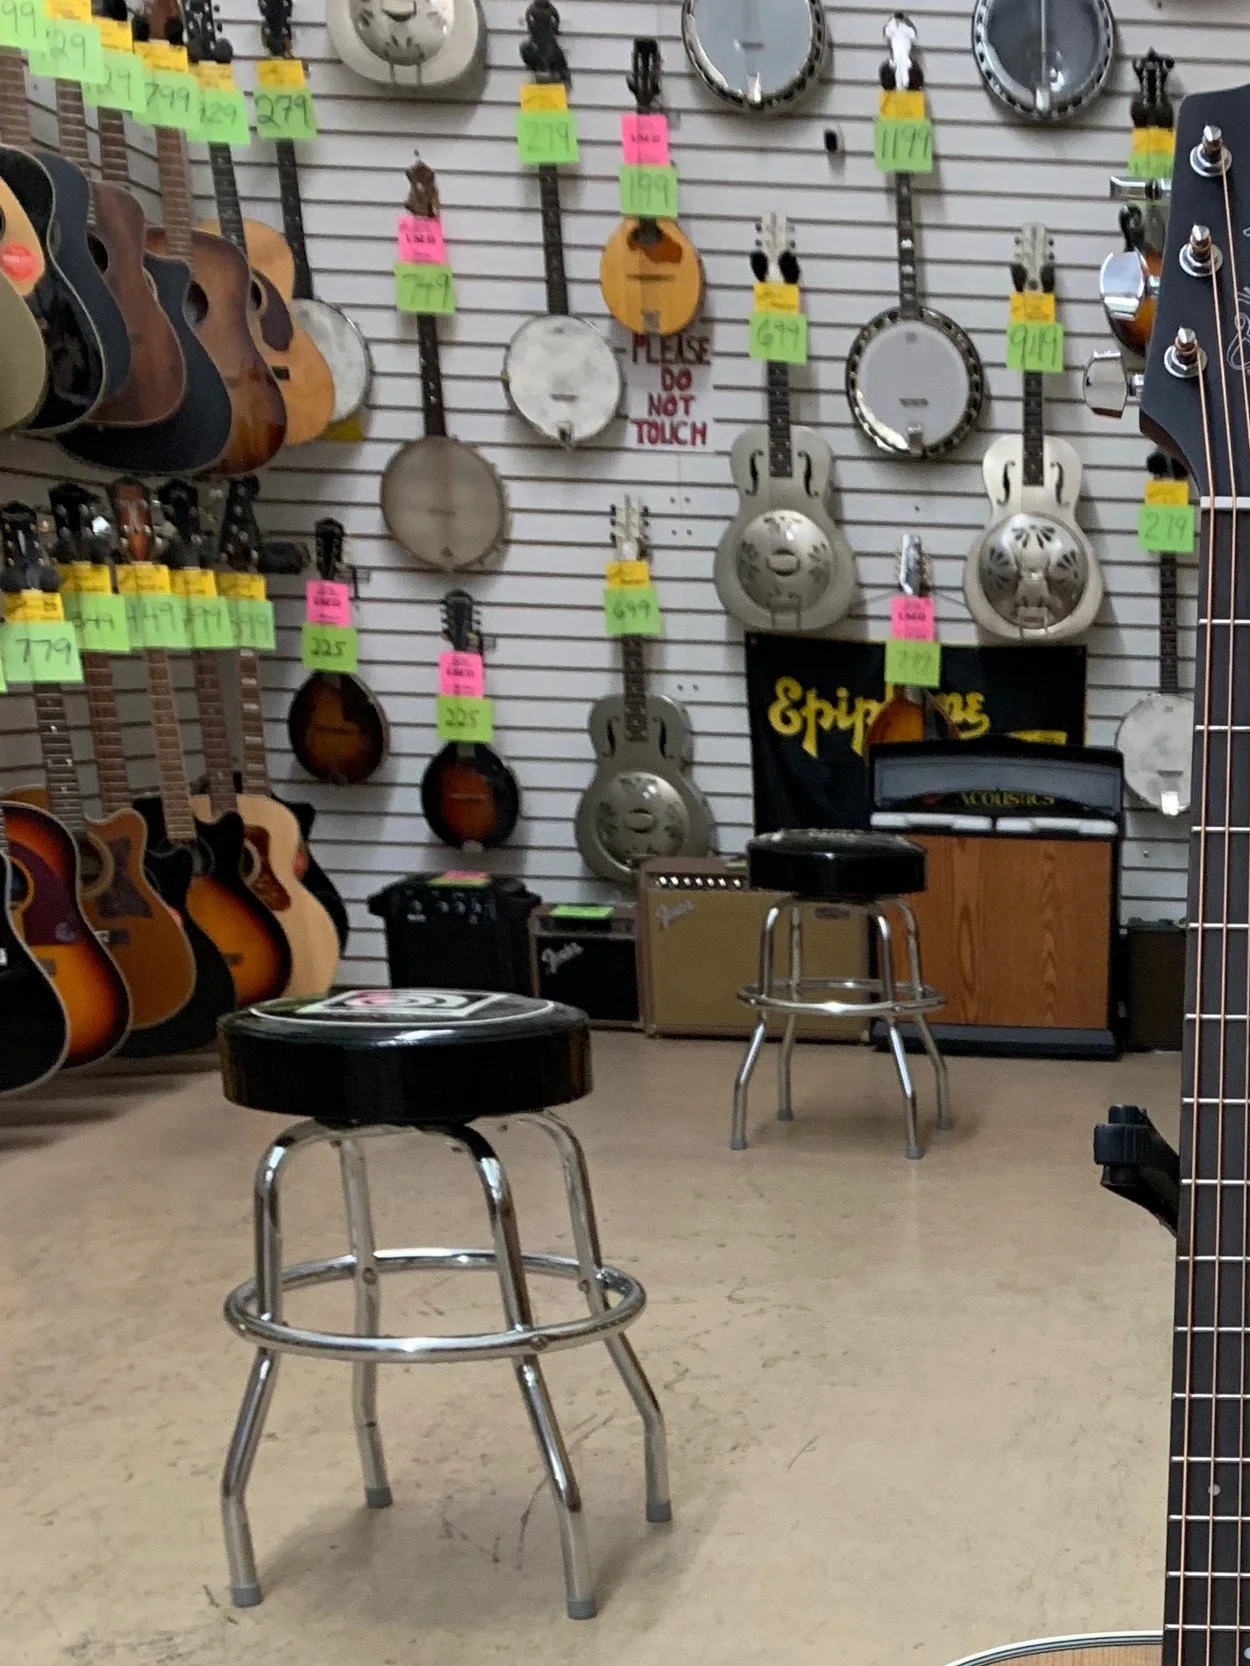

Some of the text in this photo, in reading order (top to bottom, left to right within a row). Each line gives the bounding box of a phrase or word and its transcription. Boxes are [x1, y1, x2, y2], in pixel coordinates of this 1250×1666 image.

[144, 81, 190, 113] 799
[255, 94, 311, 131] 279
[524, 120, 570, 153] 279
[881, 124, 931, 159] 1199
[631, 331, 711, 366] PLEASE
[660, 365, 693, 392] DO
[648, 392, 696, 418] NOT
[629, 416, 709, 447] TOUCH
[1144, 510, 1188, 541] 279
[15, 637, 73, 667] 779
[310, 636, 348, 657] 225
[445, 706, 481, 729] 225
[767, 675, 991, 760] Epipne
